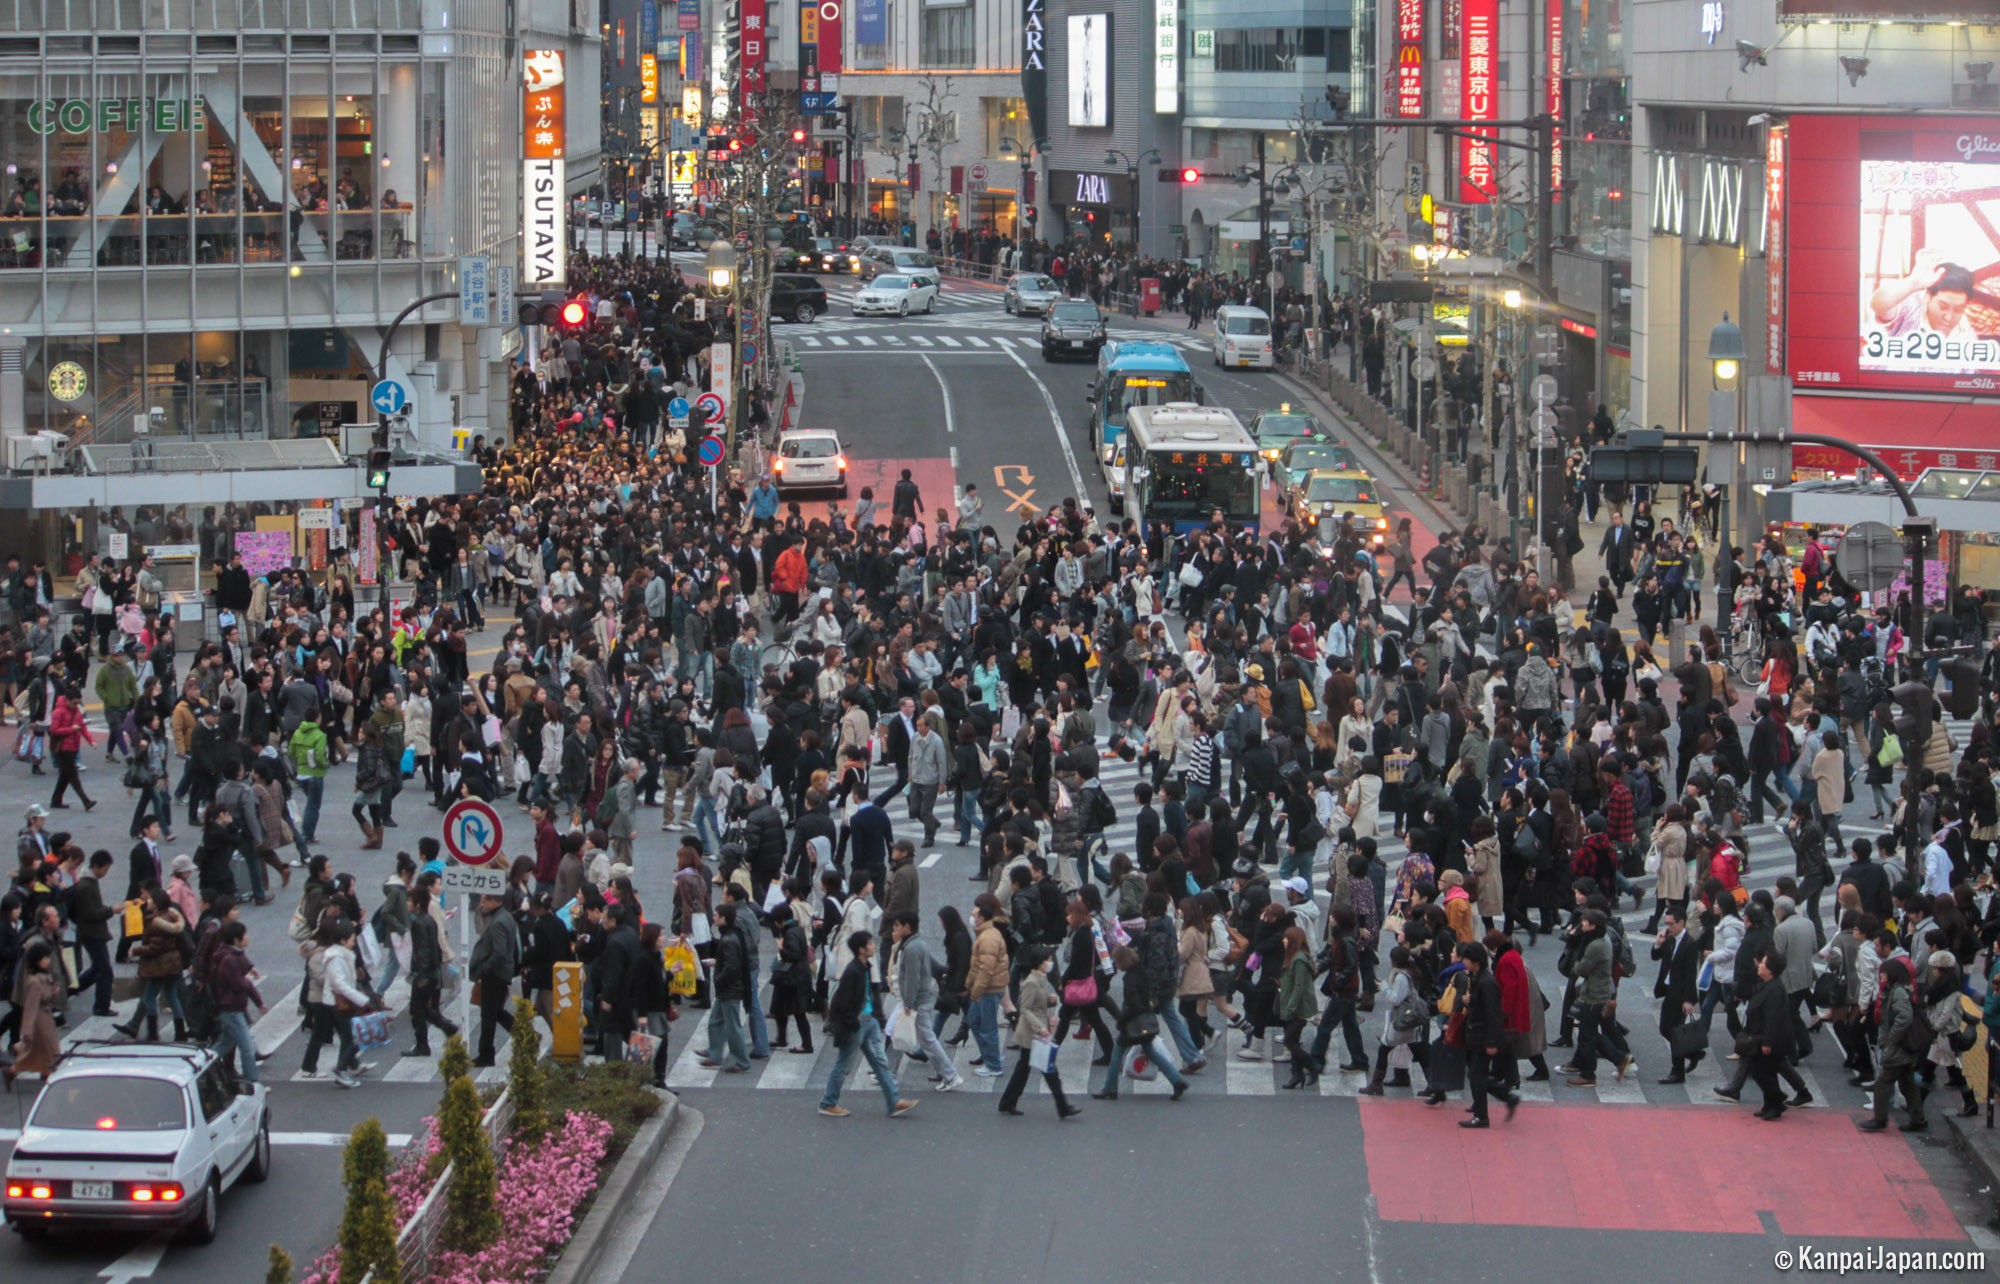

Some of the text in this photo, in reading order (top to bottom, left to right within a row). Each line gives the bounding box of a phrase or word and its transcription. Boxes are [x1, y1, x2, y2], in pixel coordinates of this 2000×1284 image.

[1025, 0, 1044, 70] ZARA
[27, 99, 205, 134] COFFEE
[535, 96, 553, 145] ぷん楽
[1076, 173, 1108, 204] ZARA
[535, 159, 554, 282] TSUTAYA
[472, 261, 485, 320] 渋谷駅前
[1867, 331, 1997, 363] 3月29日(月)
[715, 348, 724, 399] 公園通
[1172, 453, 1233, 464] 渋谷駅
[1804, 451, 1841, 465] クスリ
[446, 873, 501, 888] ここから
